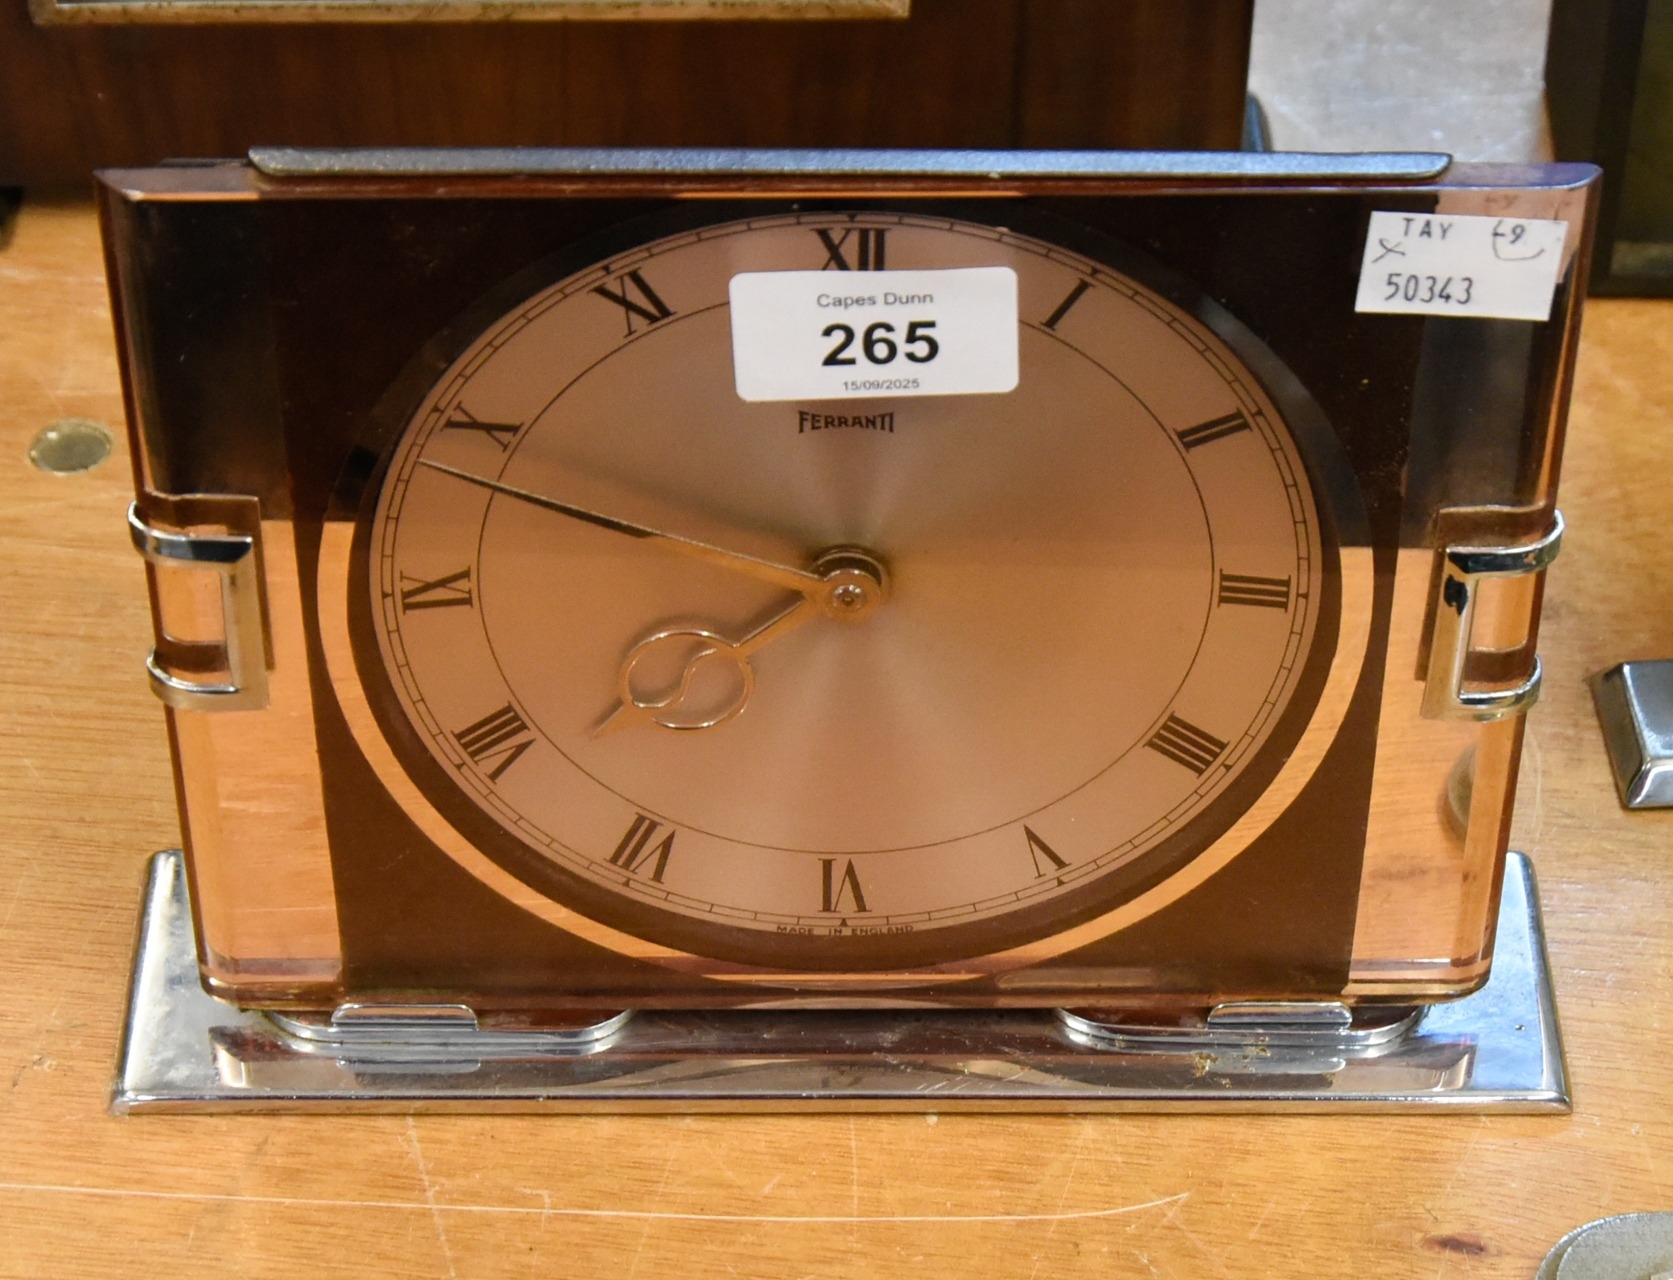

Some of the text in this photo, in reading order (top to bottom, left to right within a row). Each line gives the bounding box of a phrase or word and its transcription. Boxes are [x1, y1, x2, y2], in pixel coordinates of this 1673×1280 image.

[810, 227, 892, 271] XII
[1403, 217, 1453, 240] TAY
[586, 267, 678, 338] XI
[816, 292, 934, 309] Capes Dunn
[1384, 273, 1474, 305] 50343
[821, 320, 940, 367] 265
[842, 378, 921, 391] 15/09/2025
[440, 401, 525, 453] X
[797, 410, 894, 434] FERRANTI
[1173, 407, 1253, 454] II
[400, 565, 474, 616] IX
[1217, 568, 1292, 613] III
[450, 701, 537, 785] VIII
[603, 812, 676, 885] VII
[1023, 823, 1073, 880] V
[817, 857, 872, 913] VI
[776, 924, 915, 936] MADE IN ENGLAND
